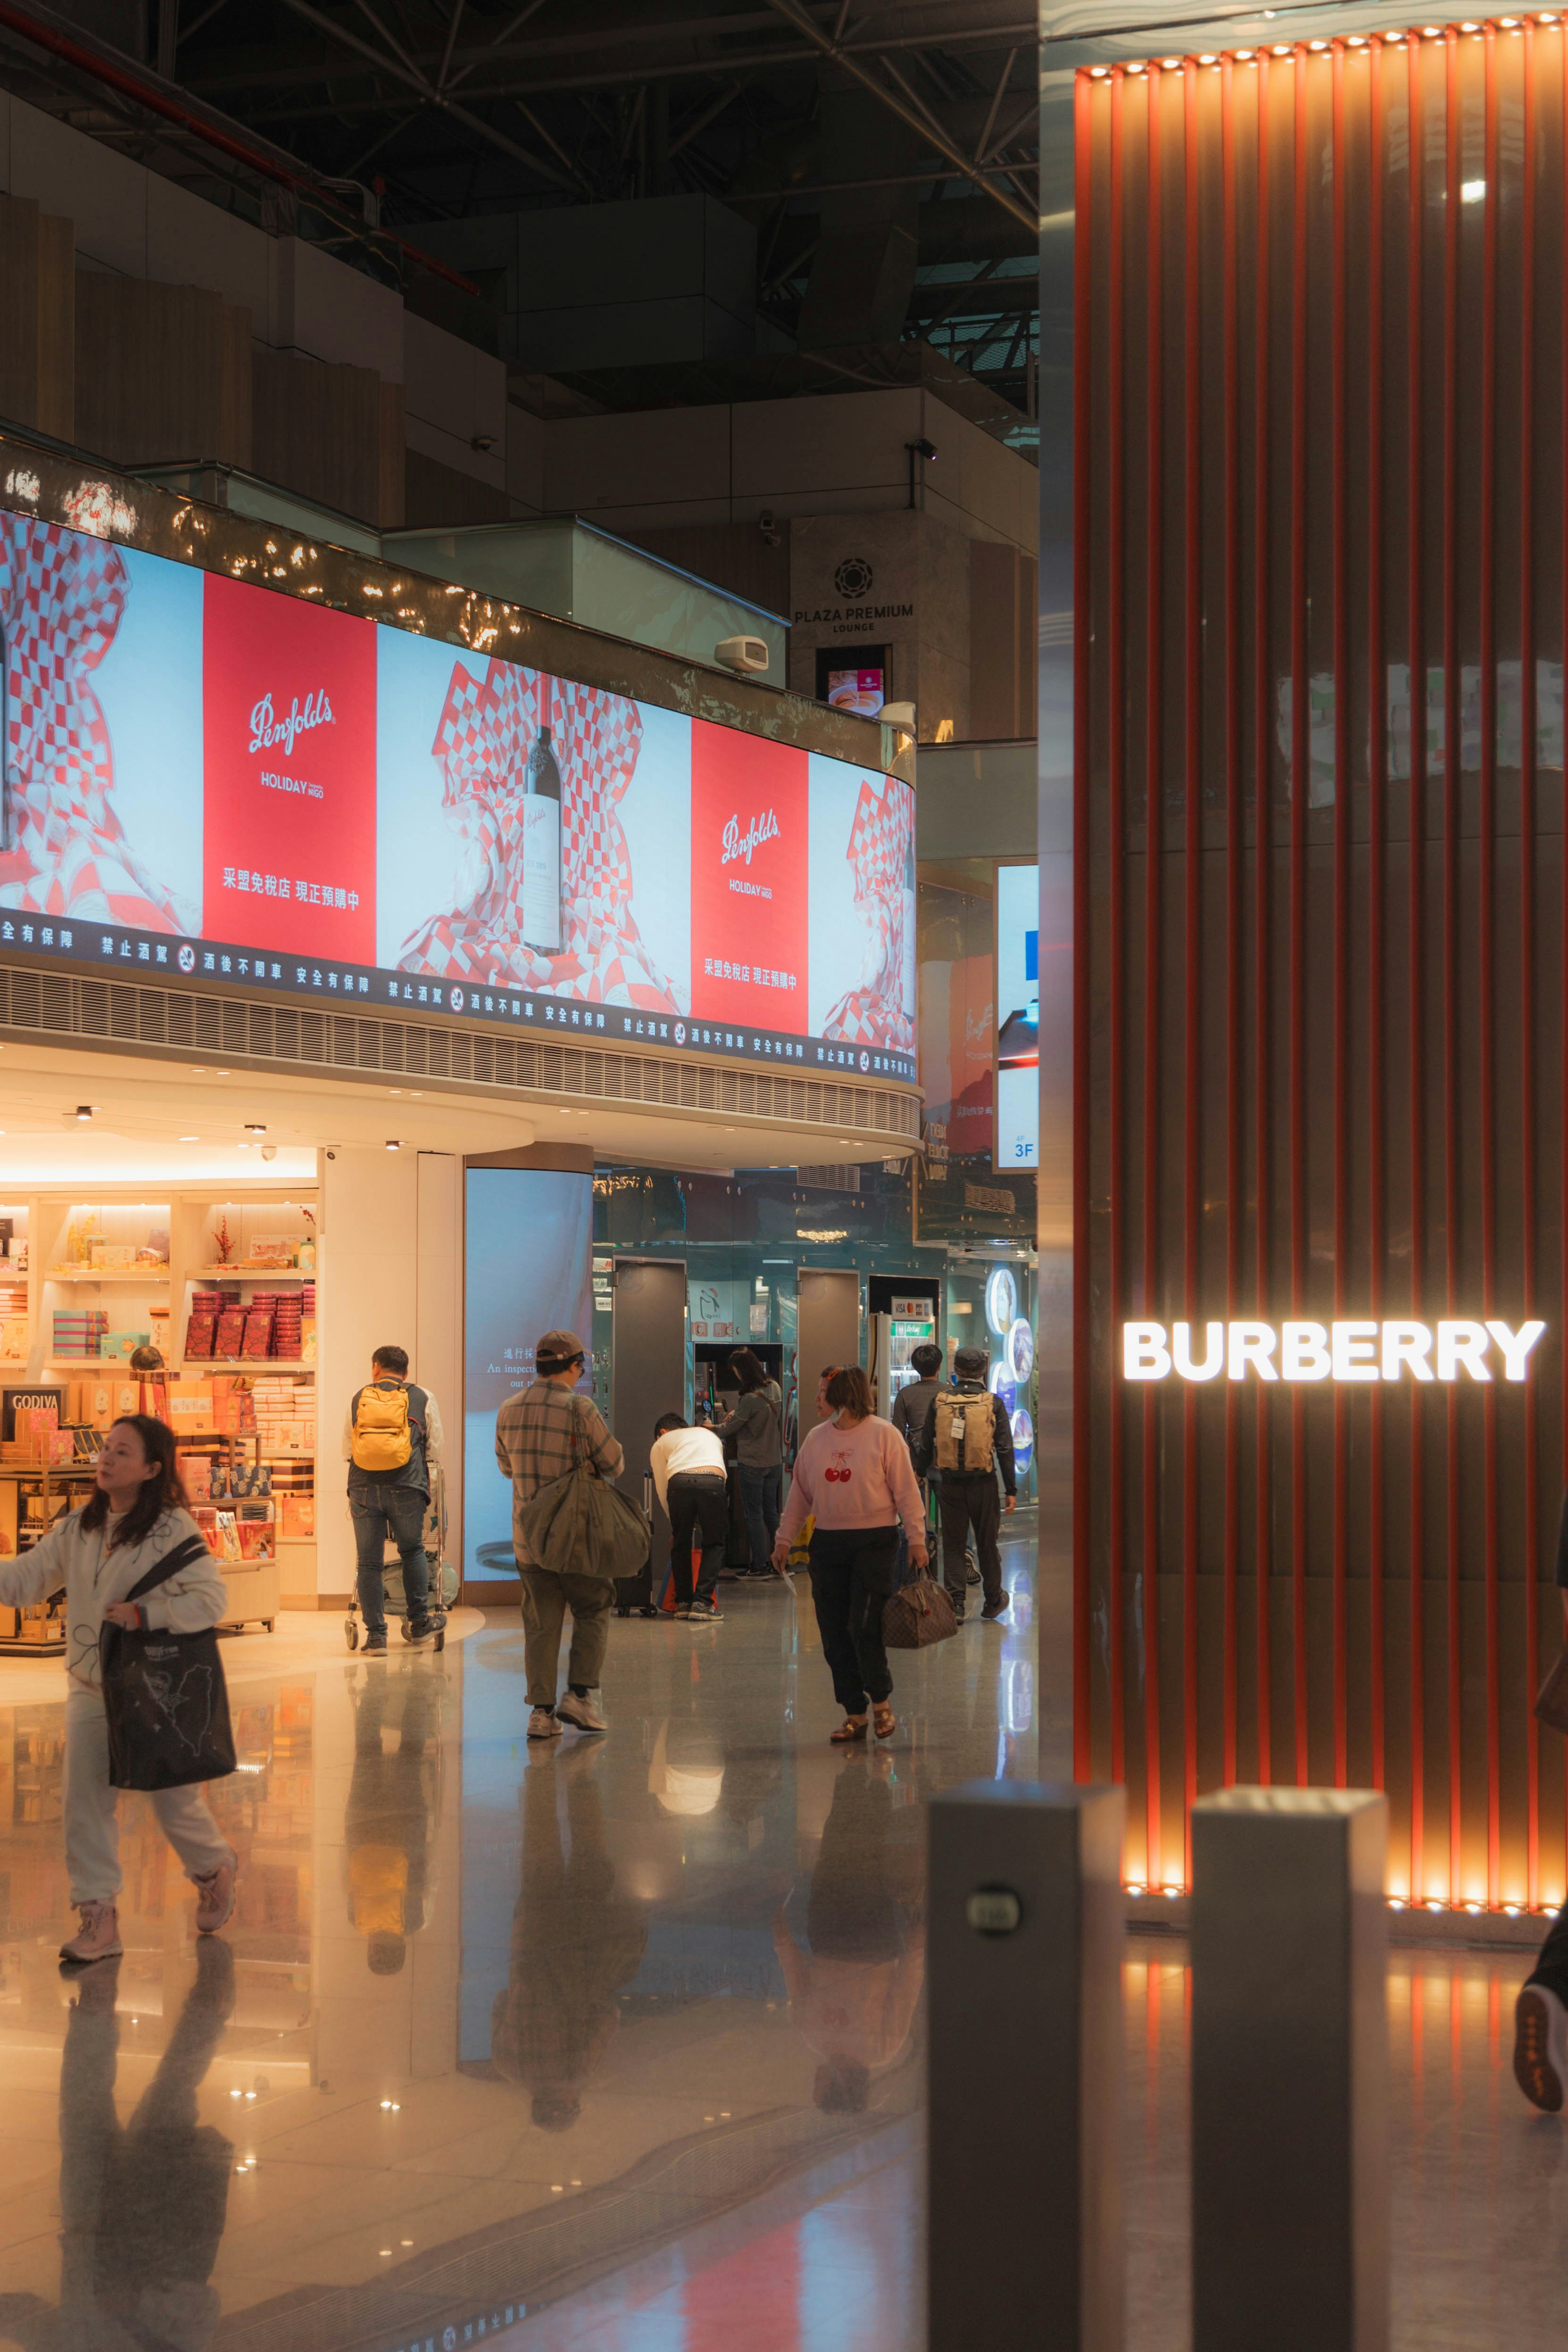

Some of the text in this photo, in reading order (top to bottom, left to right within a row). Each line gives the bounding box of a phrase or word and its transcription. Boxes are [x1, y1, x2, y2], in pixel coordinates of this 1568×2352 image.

[795, 604, 913, 623] PLAZA PREMIUM
[833, 623, 875, 633] LOUNGE
[249, 688, 332, 756] Penfolds
[261, 771, 307, 795] HOLIDAY
[308, 788, 324, 798] NIGO
[722, 808, 778, 865] Penfolds
[223, 867, 359, 911] 采盟免稅店 現正預購中
[729, 878, 761, 896] HOLIDAY
[704, 958, 797, 991] 采盟免稅店 現正預購中
[101, 936, 167, 963] 禁止酒駕
[203, 952, 282, 980] 酒後不開車
[296, 967, 369, 993] 安全有保障
[388, 980, 442, 1004] 禁止酒駕
[471, 994, 534, 1018] 酒後不開車
[545, 1005, 605, 1029] 安全有保障
[623, 1017, 668, 1038] 禁止酒駕
[691, 1027, 744, 1049] 酒後不開車
[753, 1037, 804, 1058] 安全有保障
[1015, 1135, 1026, 1143] 4F
[1015, 1144, 1034, 1158] 3F
[896, 1303, 906, 1313] VISA
[503, 1348, 536, 1360] 進行採
[1123, 1321, 1546, 1381] BURBERRY
[487, 1363, 501, 1373] An
[12, 1395, 58, 1409] GODIVA
